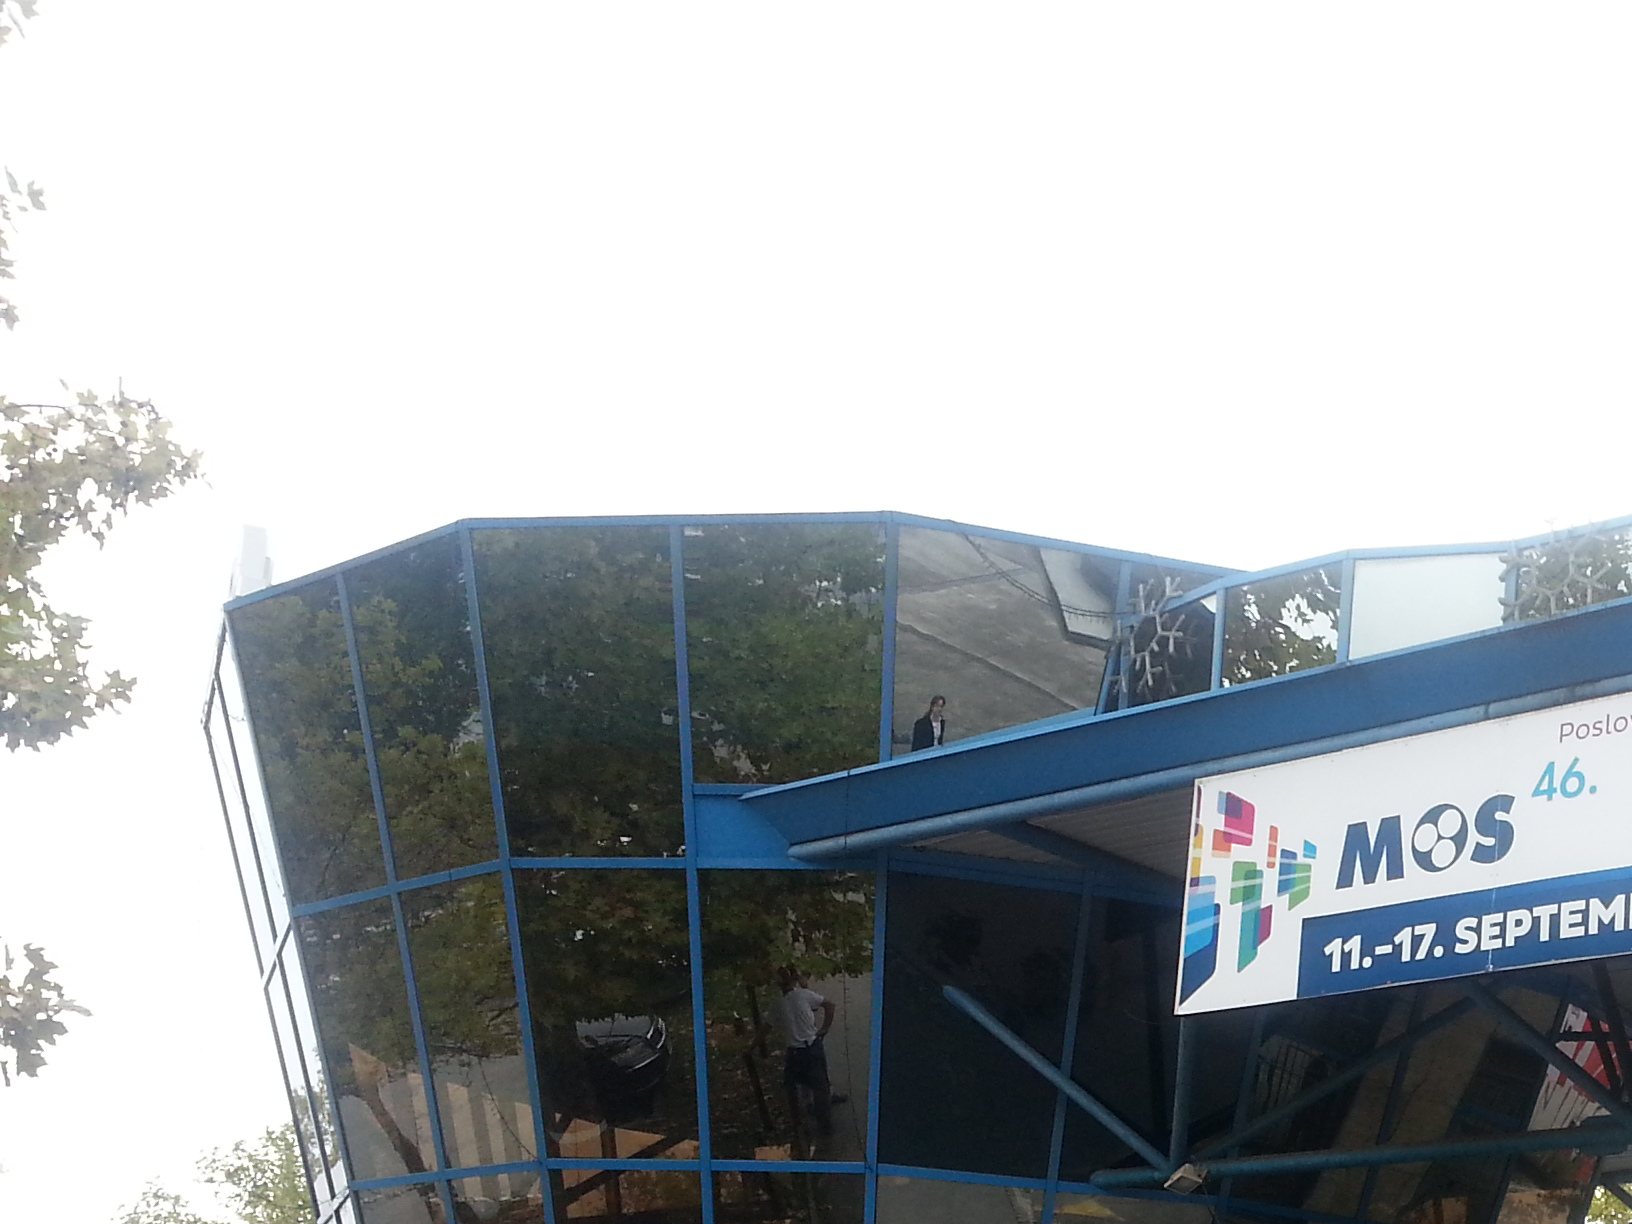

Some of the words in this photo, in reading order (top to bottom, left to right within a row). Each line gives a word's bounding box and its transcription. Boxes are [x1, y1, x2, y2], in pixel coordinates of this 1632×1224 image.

[1531, 757, 1598, 801] 46.
[1334, 793, 1516, 891] MOS
[1322, 927, 1444, 974] 11.-17.
